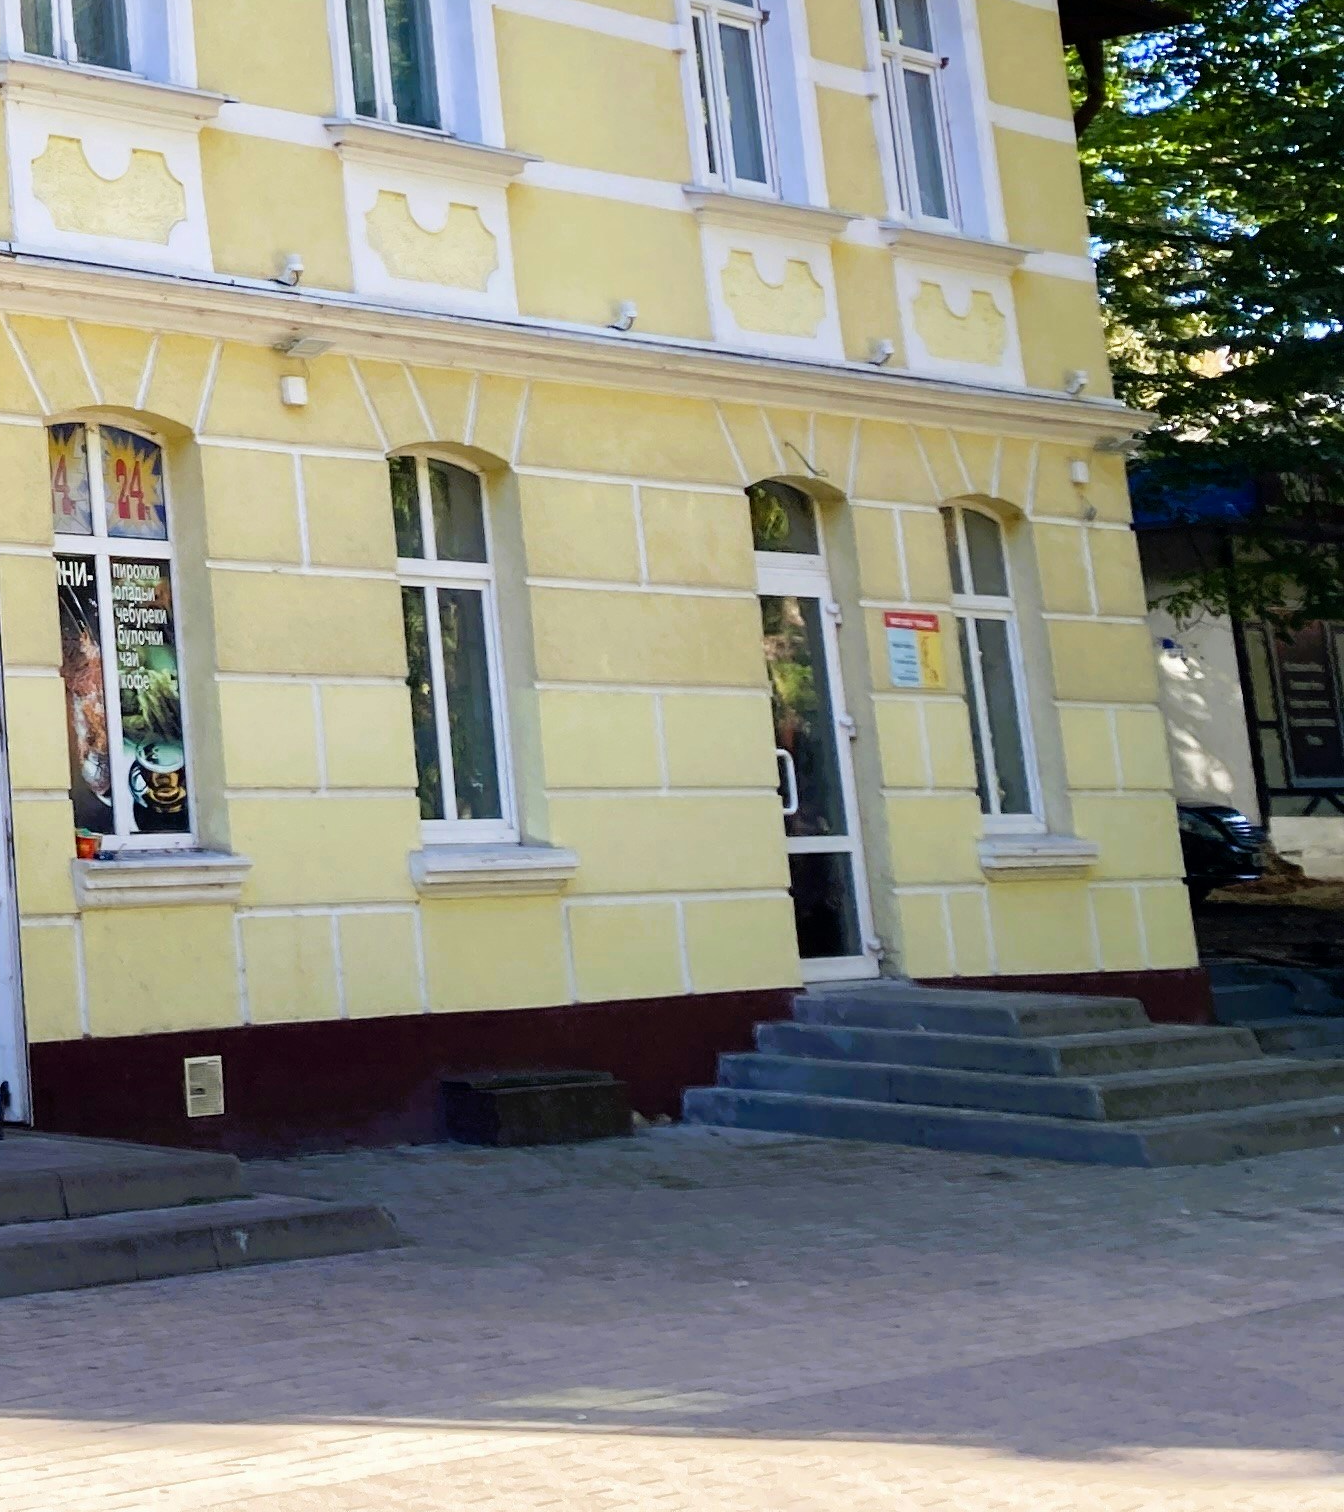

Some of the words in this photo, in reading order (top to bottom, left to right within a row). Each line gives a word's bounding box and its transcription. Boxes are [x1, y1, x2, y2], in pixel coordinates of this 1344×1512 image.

[112, 563, 161, 581] пирожки
[114, 585, 156, 603] оладьи
[115, 603, 168, 628] чебуреки
[117, 624, 164, 650] булочки
[118, 648, 140, 667] чай
[119, 670, 150, 692] кофе
